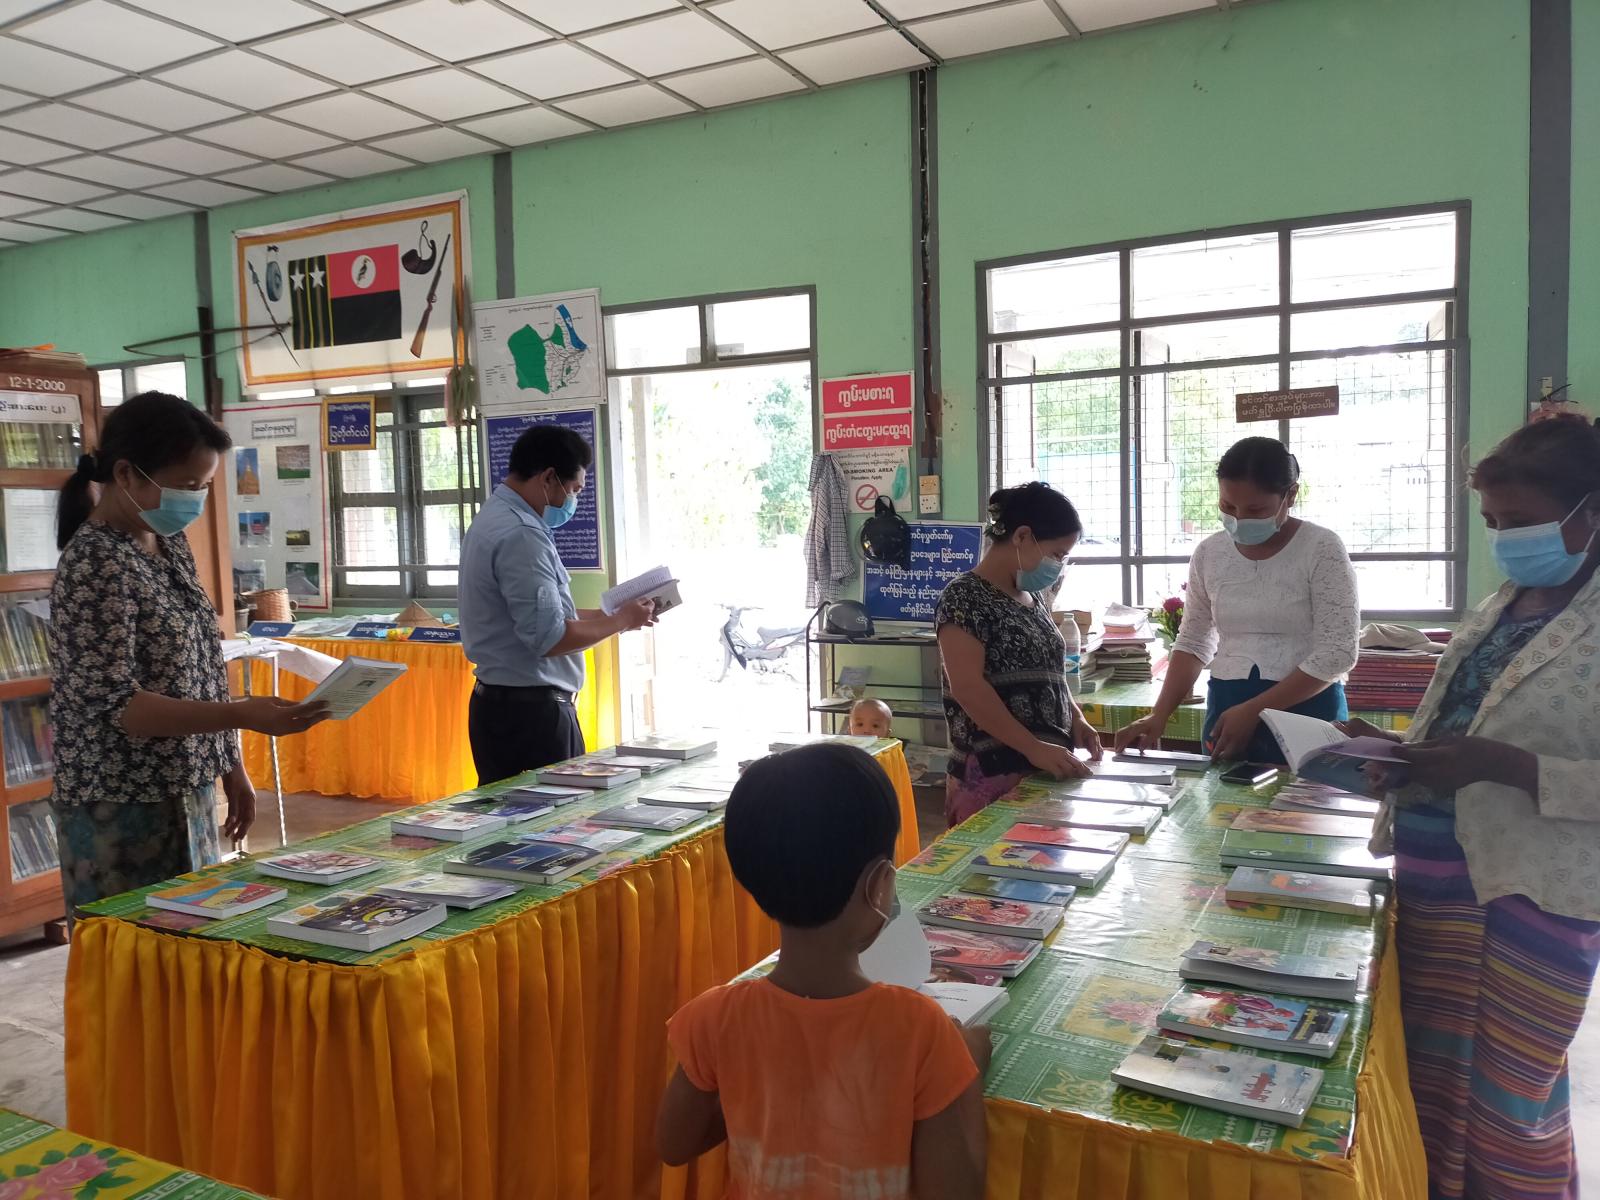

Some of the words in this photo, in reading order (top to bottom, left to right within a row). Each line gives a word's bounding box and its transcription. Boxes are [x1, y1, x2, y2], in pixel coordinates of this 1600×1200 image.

[8, 376, 66, 392] 12-1-2000
[838, 384, 895, 408] ကွမ်းမစားရ
[329, 424, 370, 443] ပြတိုက်ငယ်
[826, 424, 911, 444] ကွမ်းတံတွေးမထွေးရ
